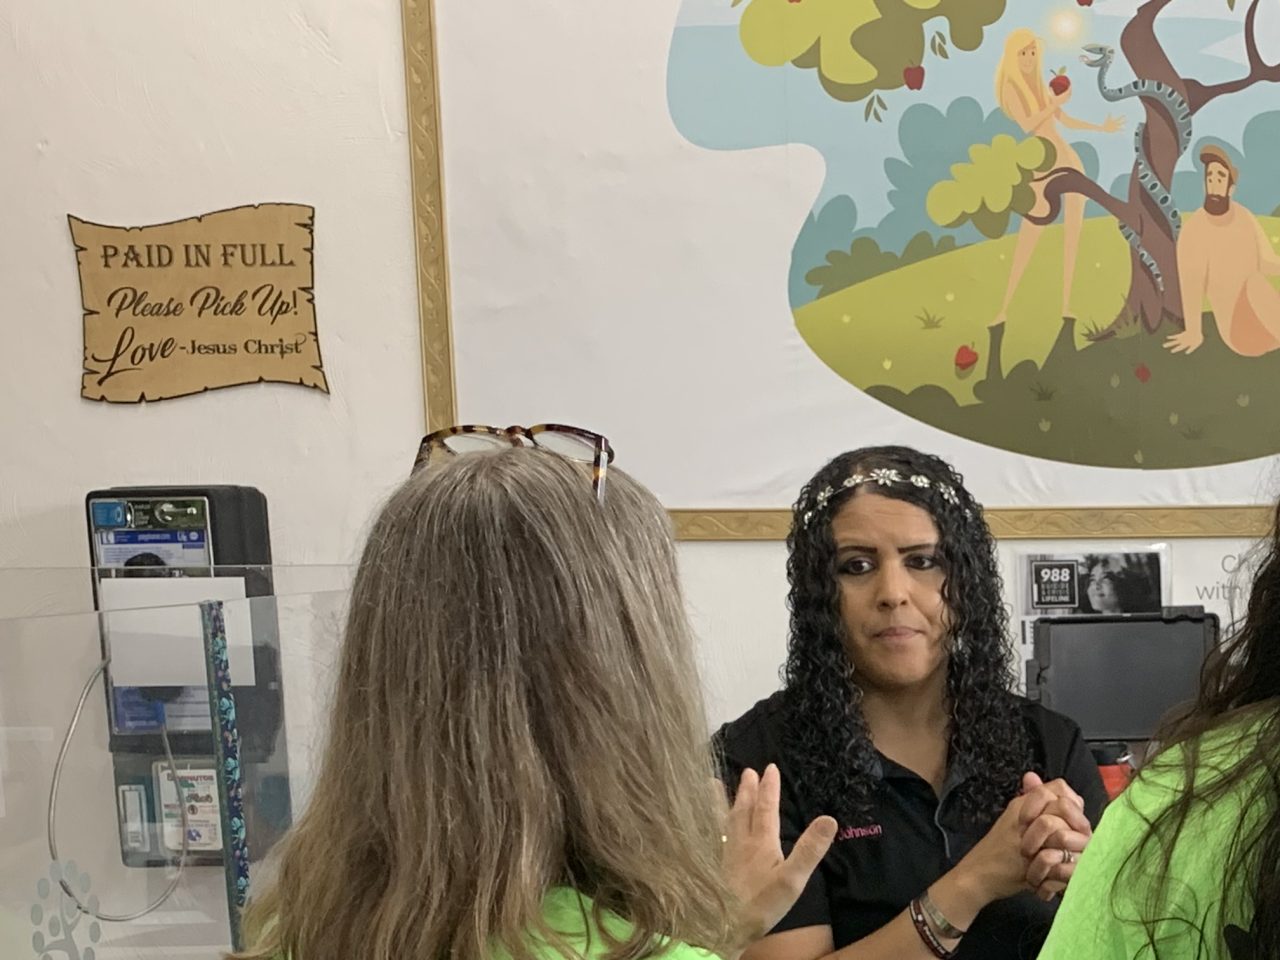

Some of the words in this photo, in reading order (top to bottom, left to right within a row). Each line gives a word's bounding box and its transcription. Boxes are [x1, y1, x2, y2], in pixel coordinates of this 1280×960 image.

[100, 244, 173, 268] PAID
[184, 244, 211, 268] IN
[220, 243, 296, 267] FULL
[107, 285, 184, 318] Please
[190, 286, 247, 317] Pick
[251, 283, 300, 325] Up!
[91, 326, 178, 387] Love
[243, 333, 307, 359] Christ
[1040, 568, 1070, 582] 988
